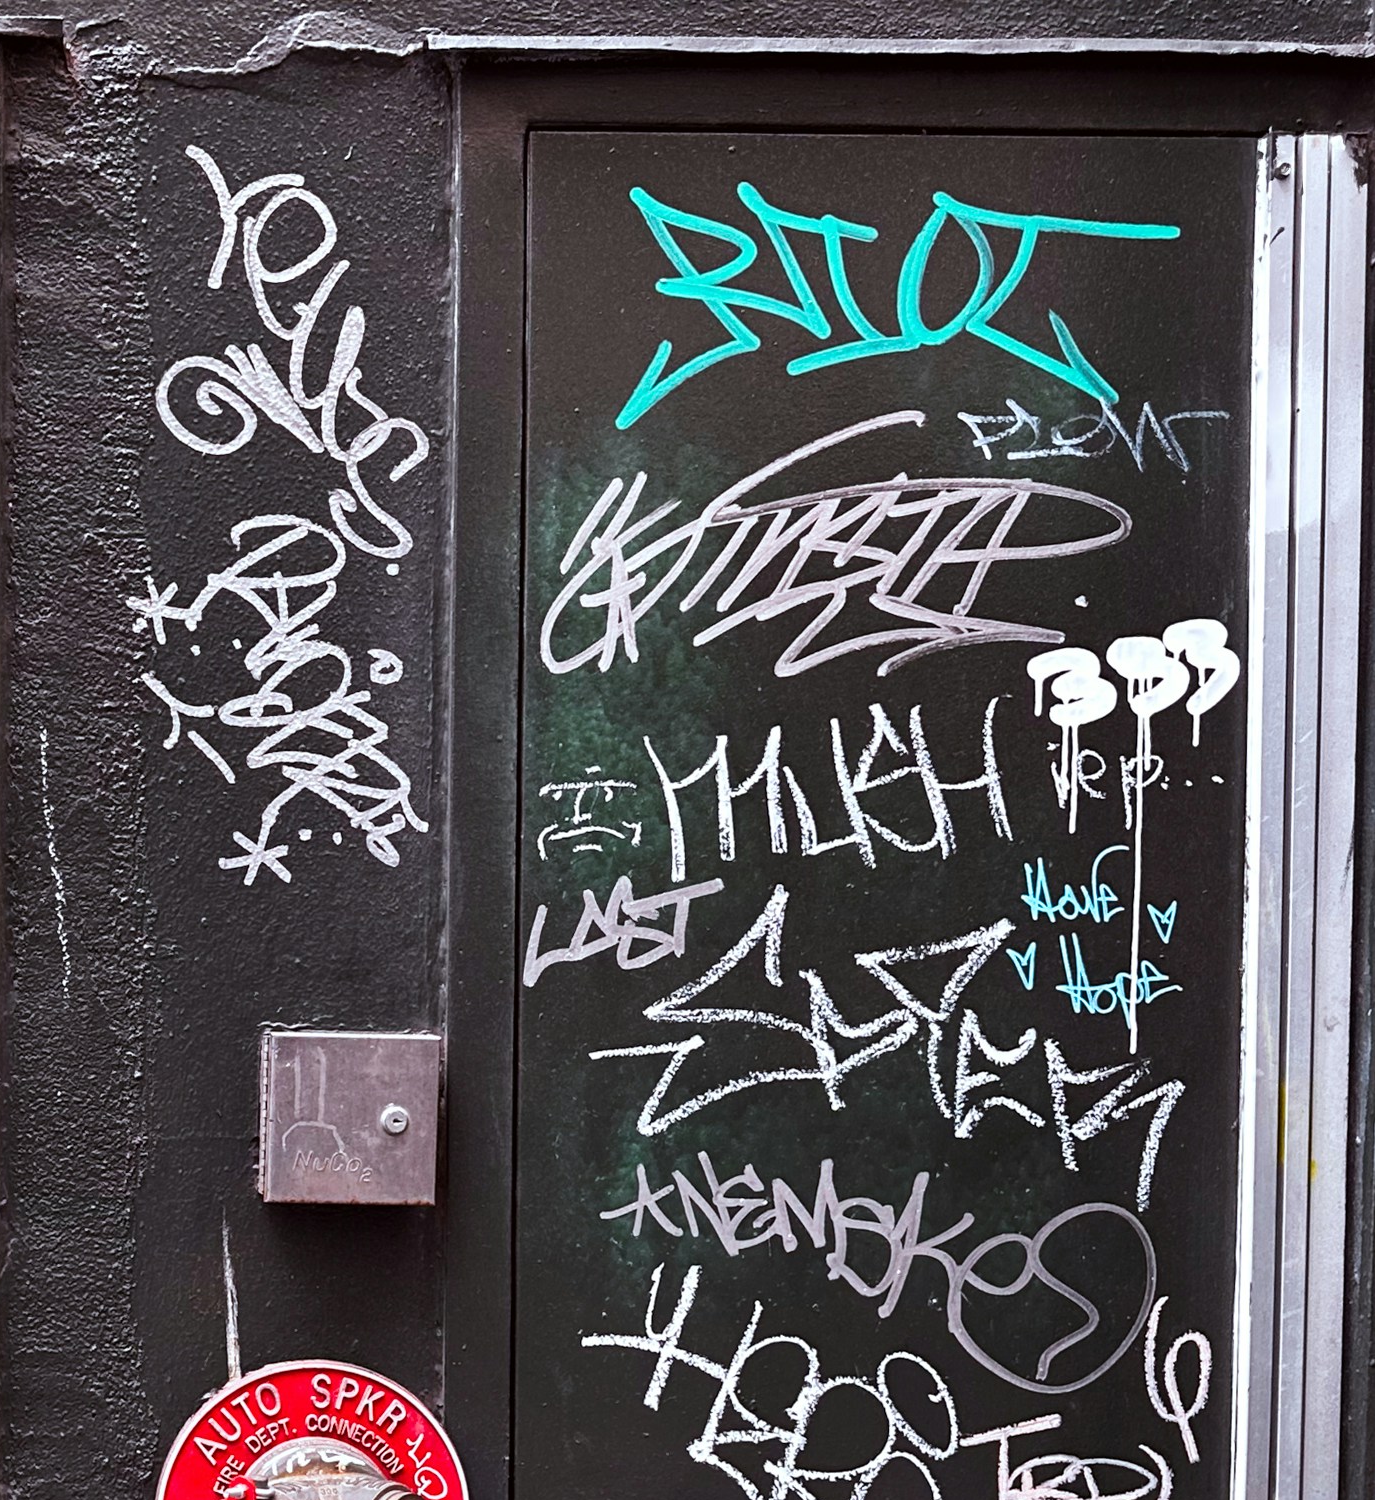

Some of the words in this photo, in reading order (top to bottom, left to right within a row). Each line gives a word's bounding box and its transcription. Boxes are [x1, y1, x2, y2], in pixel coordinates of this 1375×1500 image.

[193, 1382, 282, 1466] AUTO
[309, 1373, 407, 1435] SPKR
[213, 1455, 246, 1495] FIRE
[244, 1417, 298, 1454] DEPT.
[304, 1413, 404, 1475] CONNECTION
